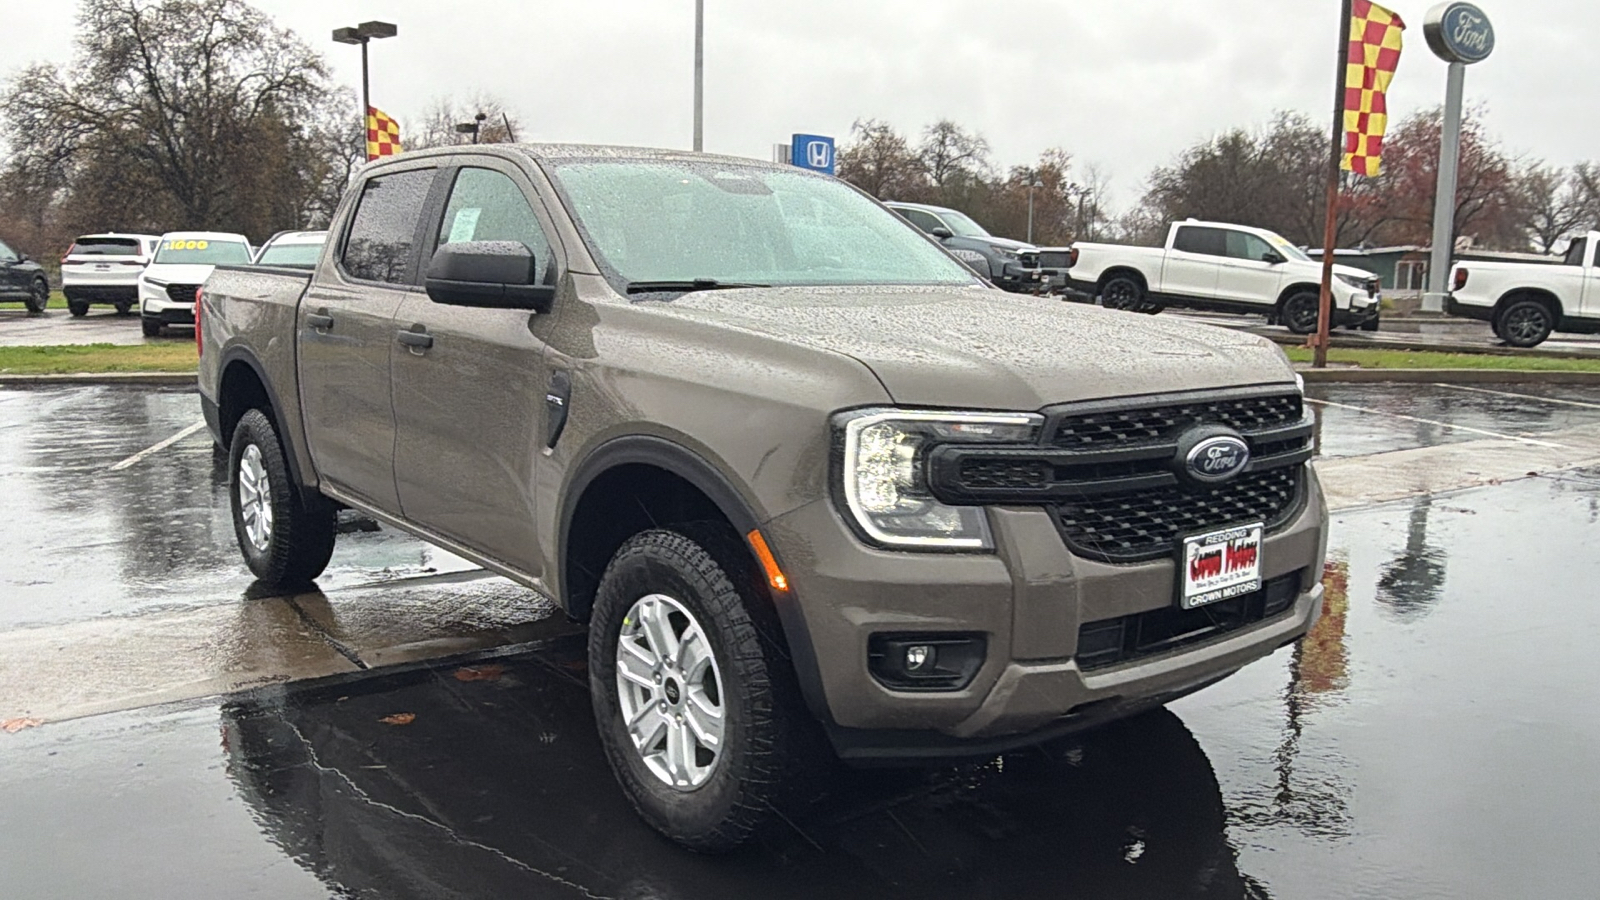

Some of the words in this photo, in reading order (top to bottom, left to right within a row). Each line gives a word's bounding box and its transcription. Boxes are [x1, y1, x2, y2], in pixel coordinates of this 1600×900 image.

[1454, 11, 1489, 51] Ford
[1204, 446, 1238, 472] Ford
[1205, 529, 1247, 545] REDDING
[1190, 589, 1222, 606] CROWN
[1222, 581, 1258, 598] MOTORS
